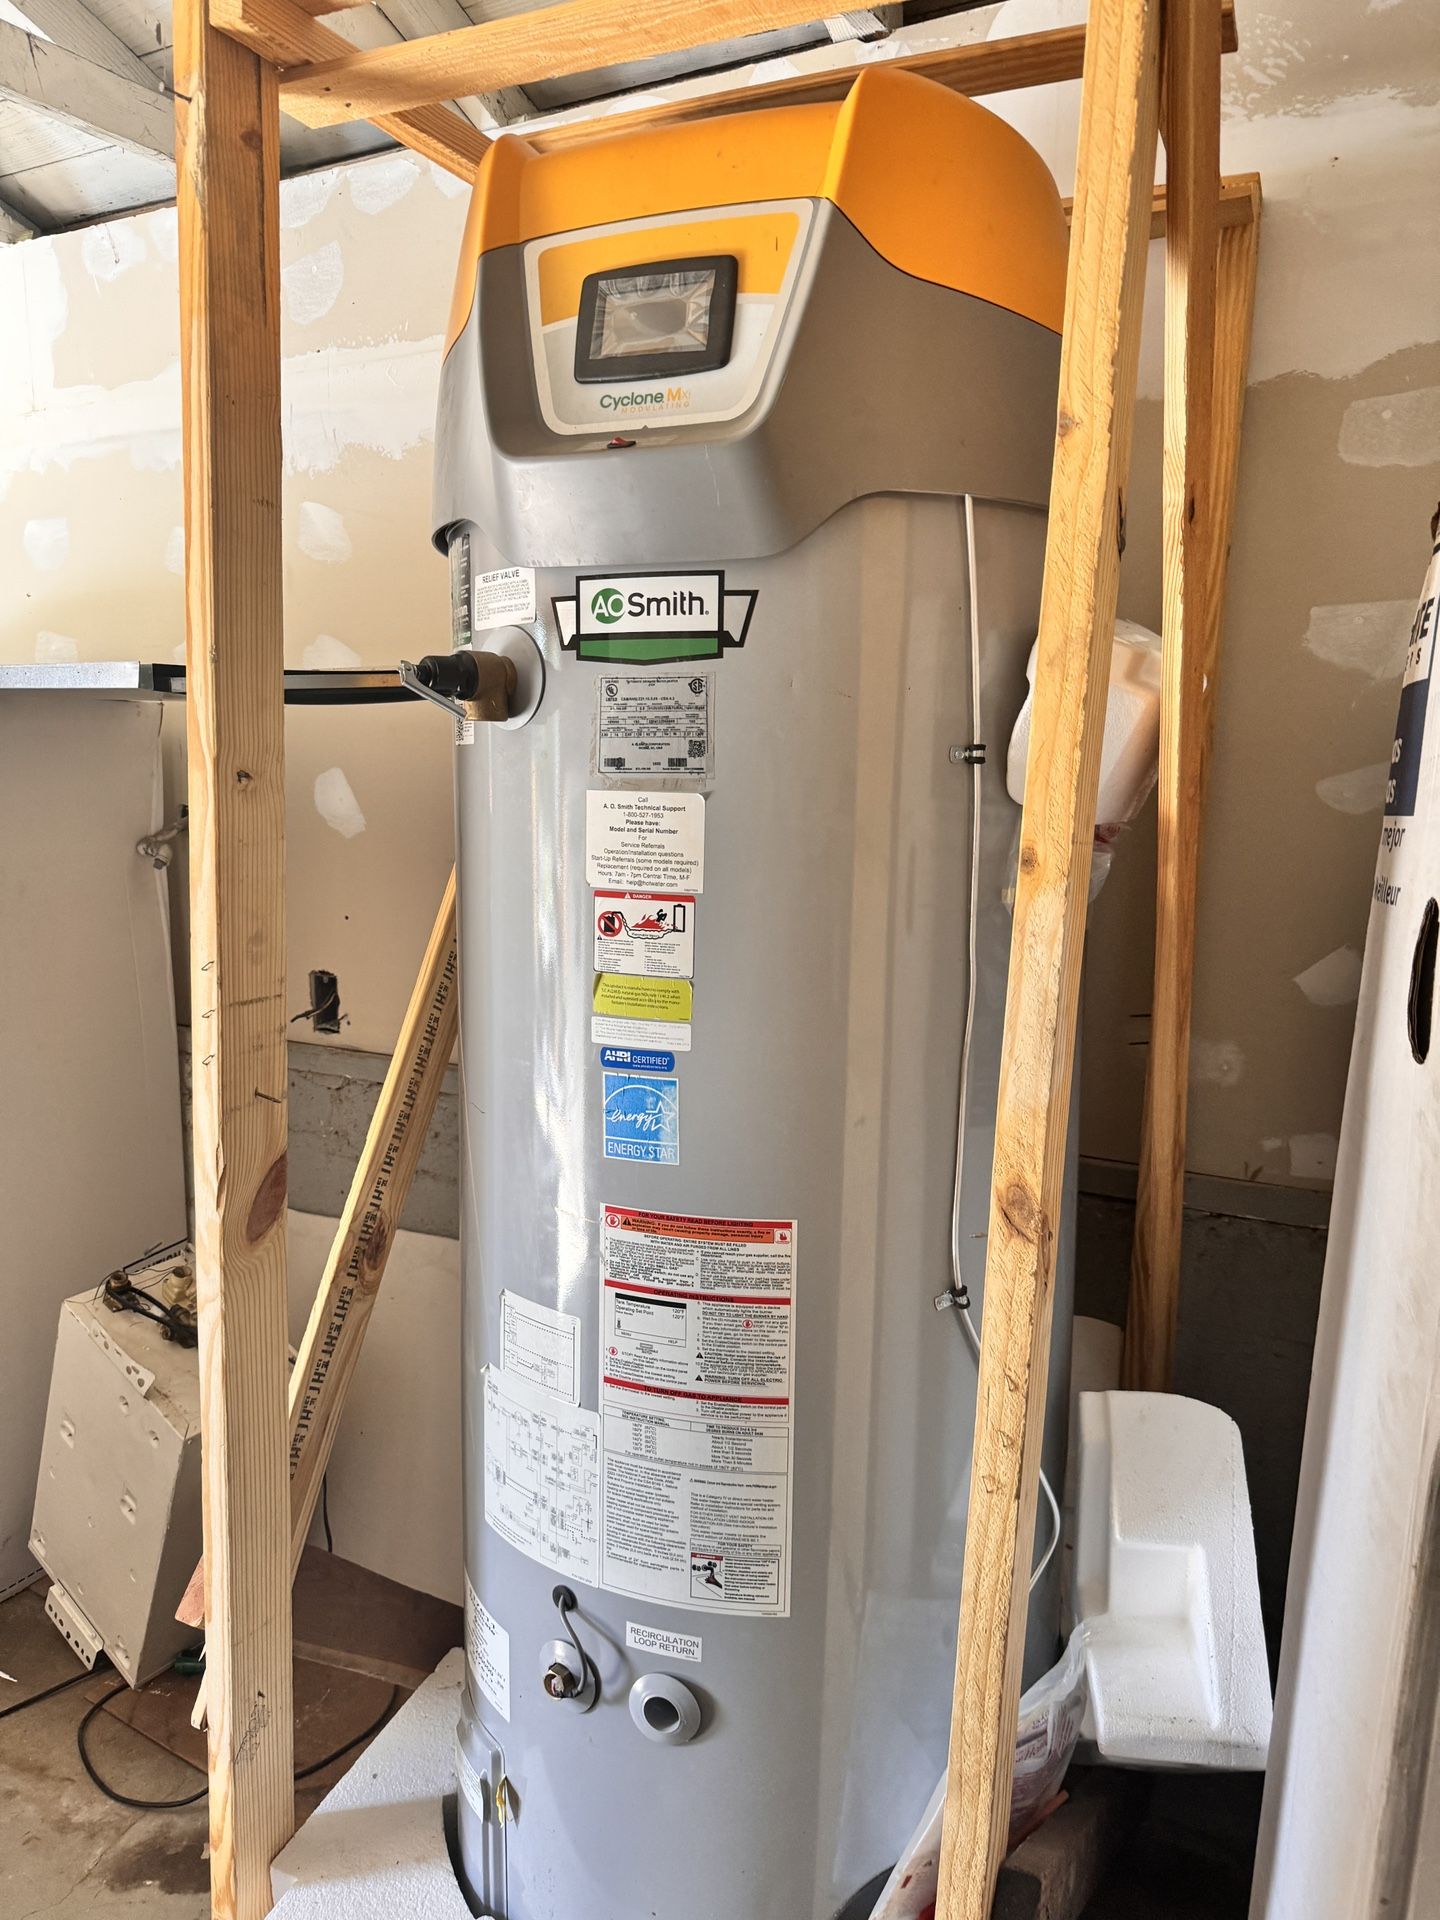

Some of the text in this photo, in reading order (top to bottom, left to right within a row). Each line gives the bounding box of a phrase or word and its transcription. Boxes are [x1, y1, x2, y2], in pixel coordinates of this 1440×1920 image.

[600, 392, 664, 411] Cyclone
[622, 400, 689, 413] MODULATING
[482, 569, 520, 584] RELIEF VALVE
[628, 590, 705, 617] Smith
[603, 848, 657, 857] Operation/Installation
[612, 855, 635, 863] Referrals
[597, 862, 629, 870] Replacement
[626, 878, 678, 888] help@hotwater.com
[604, 1050, 668, 1065] AHRI CERTIFIED
[608, 1141, 675, 1160] ENERGY STAR
[665, 1214, 686, 1223] SAFETY
[616, 1305, 635, 1313] Operating
[626, 1301, 651, 1309] Temperature
[630, 1626, 699, 1649] RECIRCULATION
[633, 1636, 695, 1656] LOOP RETURN
